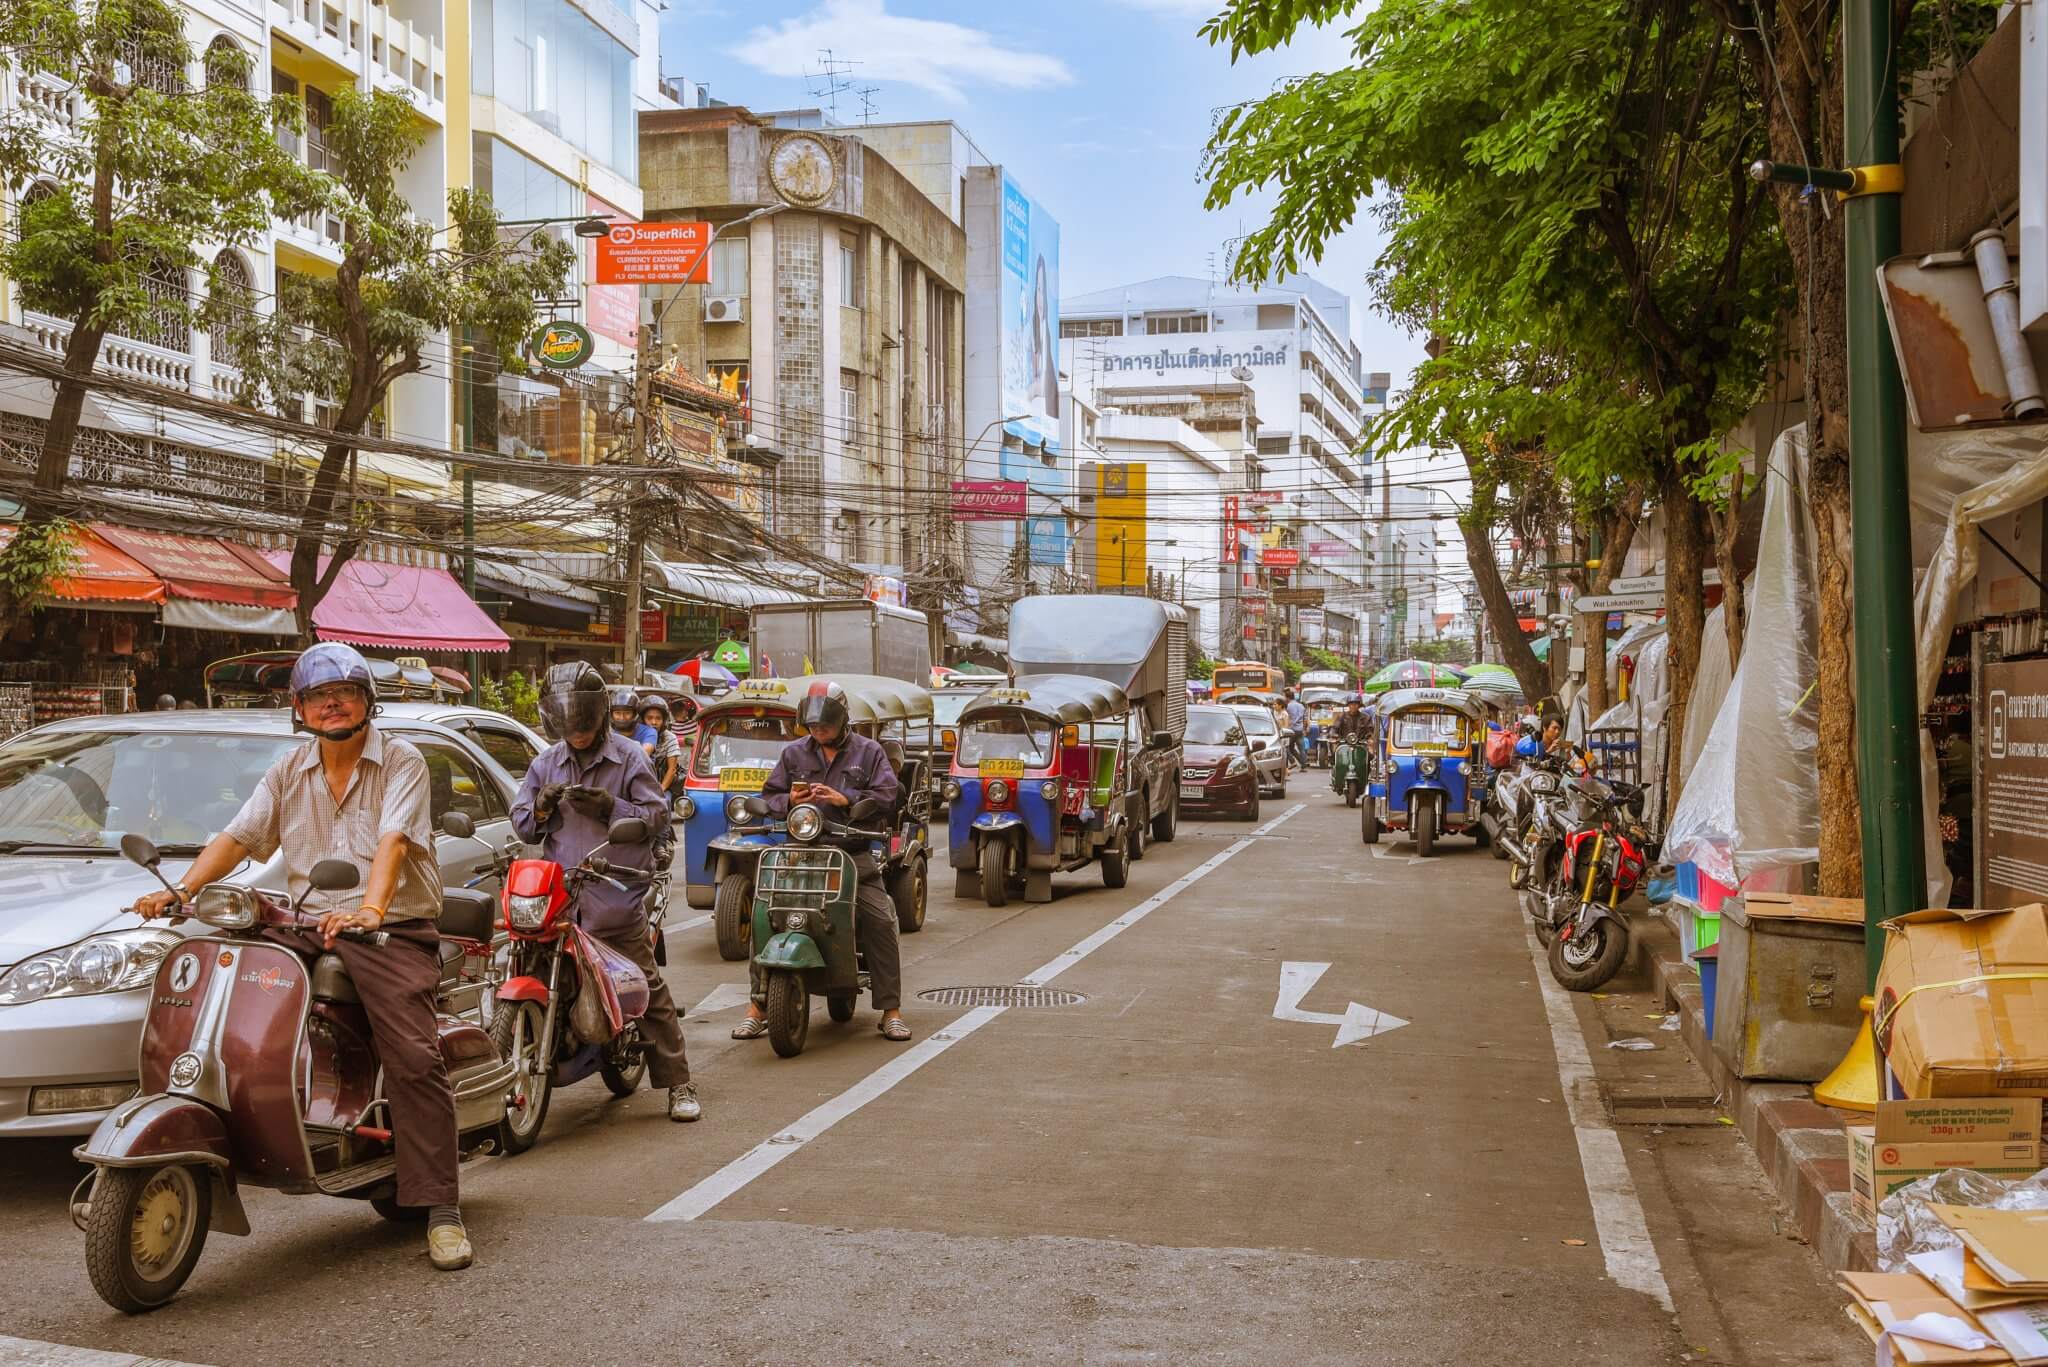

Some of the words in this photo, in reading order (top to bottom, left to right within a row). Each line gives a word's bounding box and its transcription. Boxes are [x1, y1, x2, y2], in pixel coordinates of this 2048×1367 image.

[636, 227, 696, 242] SuperRich
[616, 256, 651, 264] CURRENCY
[1592, 600, 1605, 608] Wat
[745, 682, 775, 691] TAXI
[1420, 691, 1440, 699] TAXI
[1905, 1109, 1940, 1118] Vegetable
[1942, 1108, 1976, 1117] Crackers
[1964, 1125, 1975, 1134] 12
